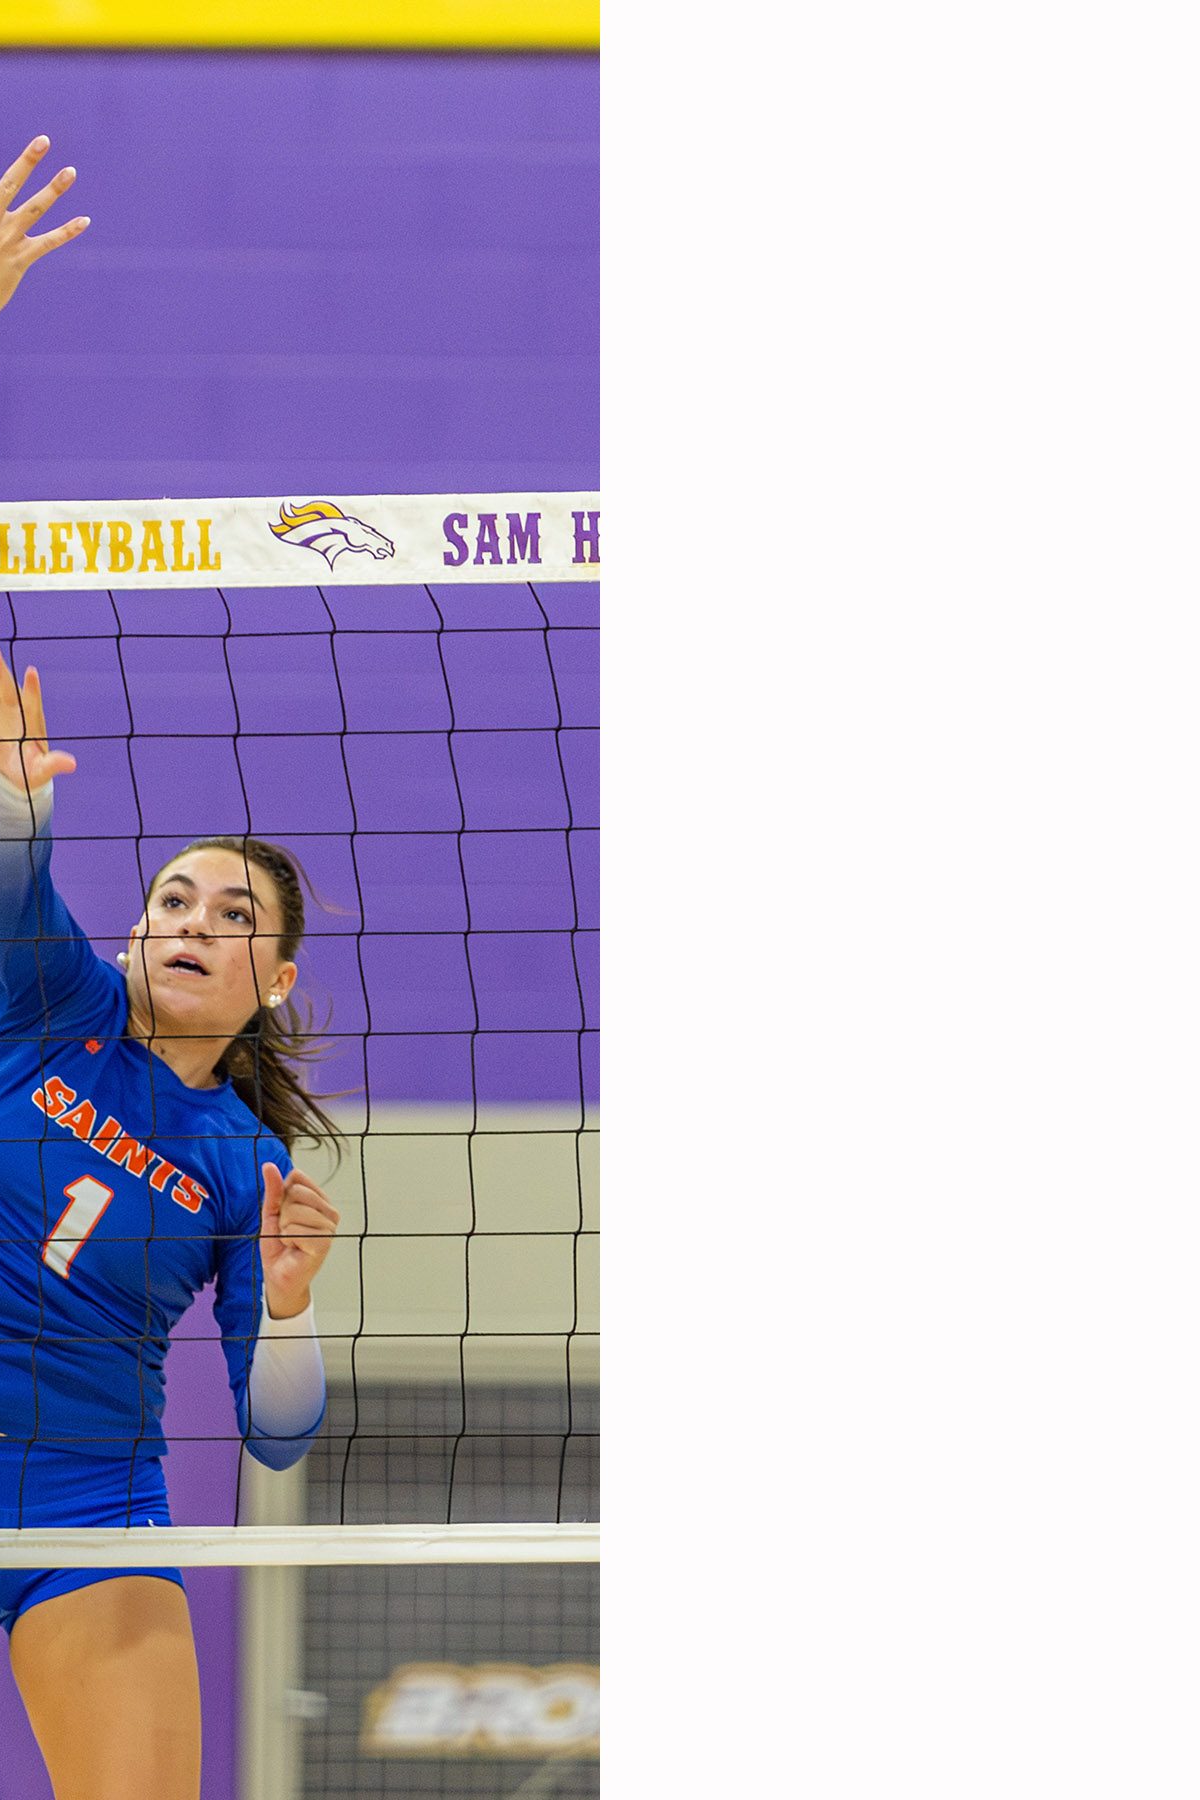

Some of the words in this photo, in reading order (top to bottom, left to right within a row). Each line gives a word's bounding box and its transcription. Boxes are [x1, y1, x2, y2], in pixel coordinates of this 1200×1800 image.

[442, 512, 542, 566] SAM
[31, 1075, 210, 1213] SAINTS
[41, 1173, 114, 1280] 1
